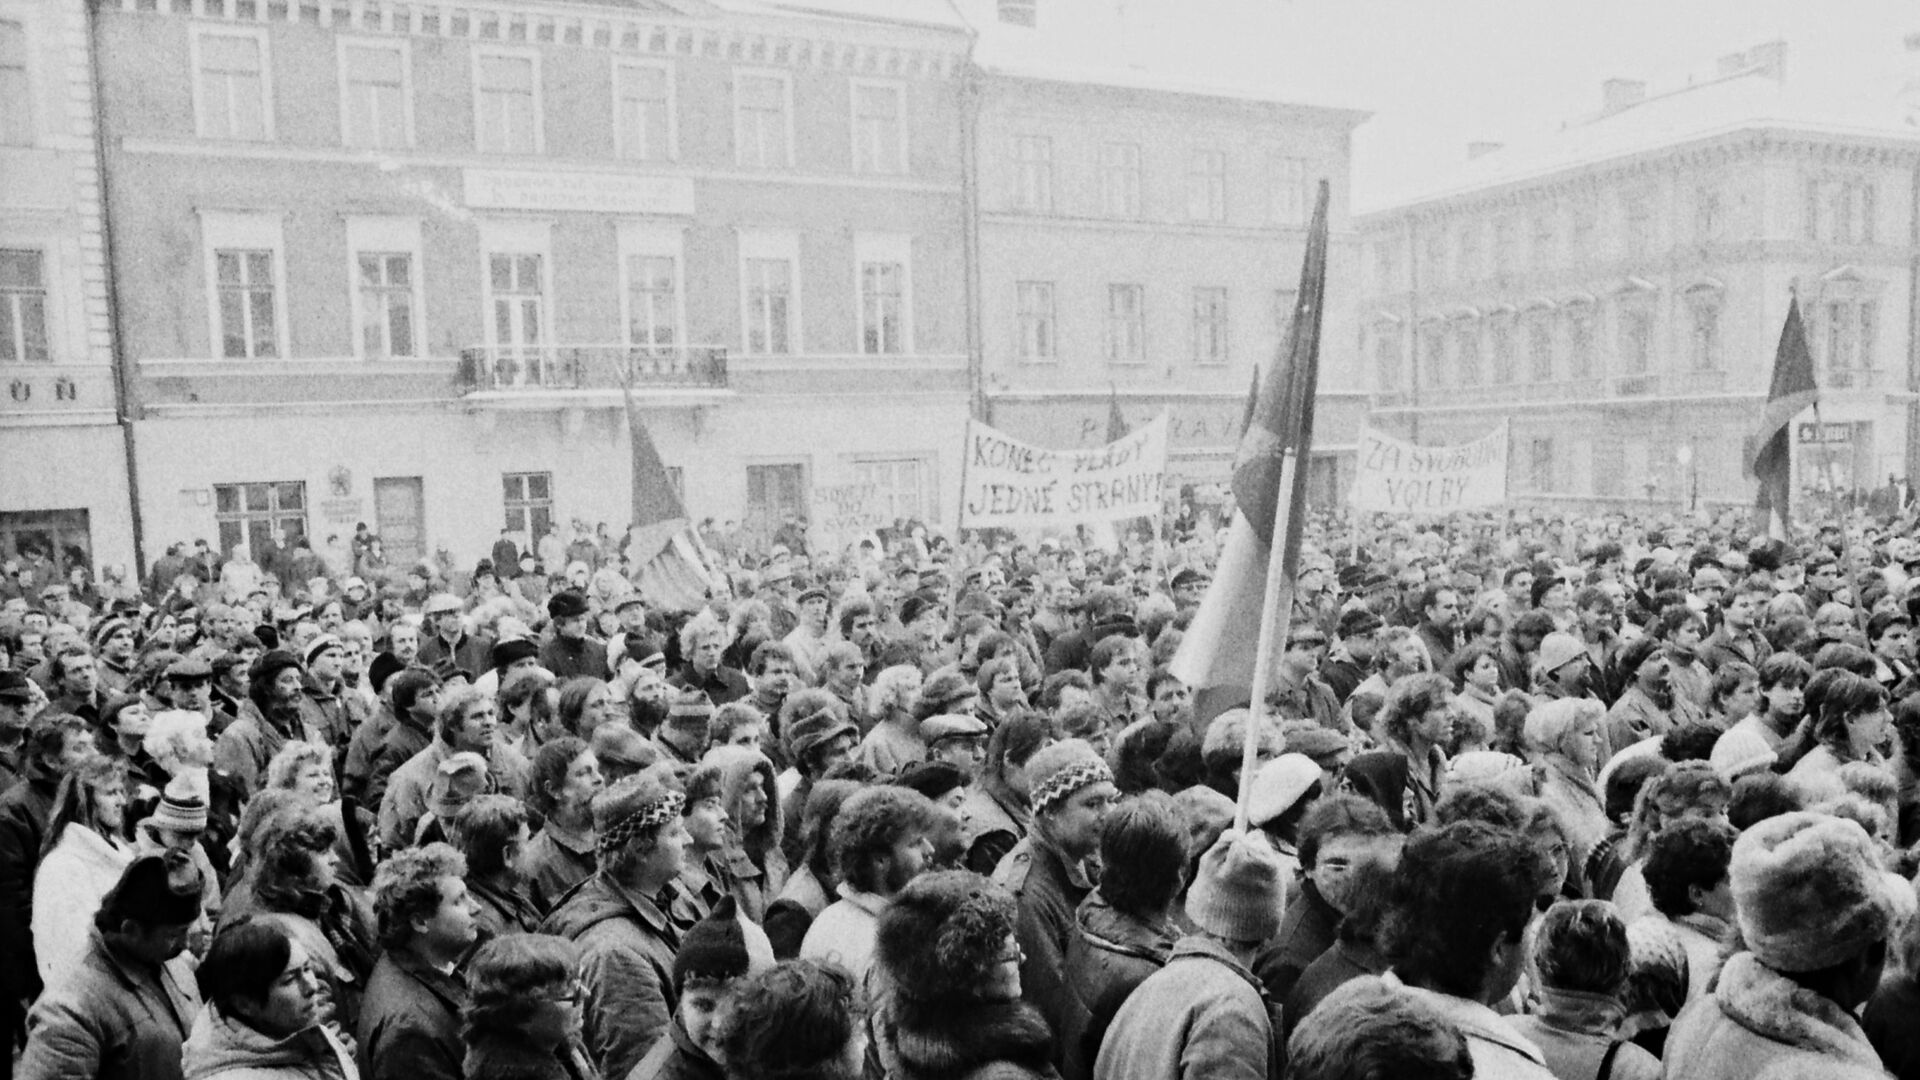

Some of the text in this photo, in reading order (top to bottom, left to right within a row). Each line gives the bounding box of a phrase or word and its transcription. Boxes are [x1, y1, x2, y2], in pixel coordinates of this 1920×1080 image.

[972, 434, 1056, 474] KONEC
[1365, 436, 1400, 472] ZA
[967, 472, 1163, 516] JEDNÉ STRANY!
